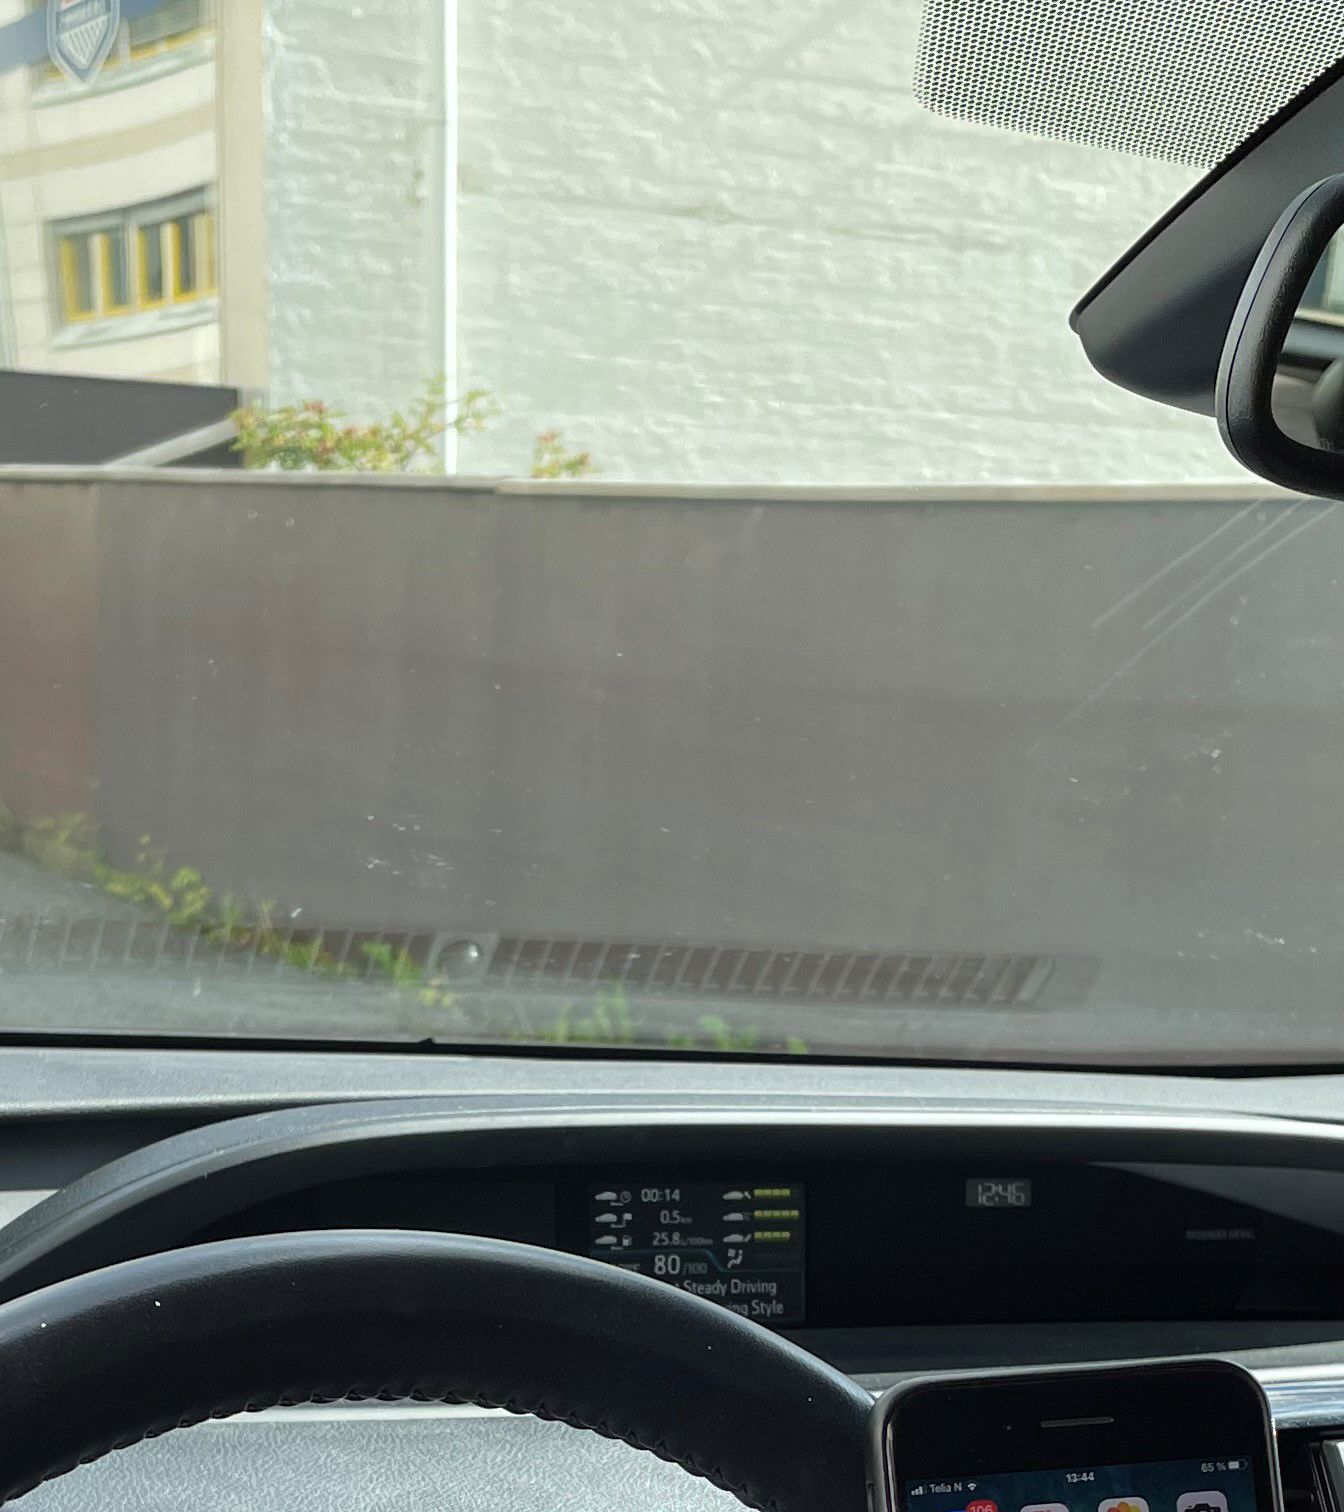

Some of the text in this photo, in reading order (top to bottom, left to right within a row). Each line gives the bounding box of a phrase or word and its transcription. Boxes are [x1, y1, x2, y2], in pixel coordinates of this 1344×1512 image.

[641, 1188, 680, 1203] 00:14
[977, 1182, 1025, 1206] 12:46
[654, 1254, 681, 1275] 80
[683, 1278, 777, 1297] Steady Driving
[751, 1299, 784, 1317] Style
